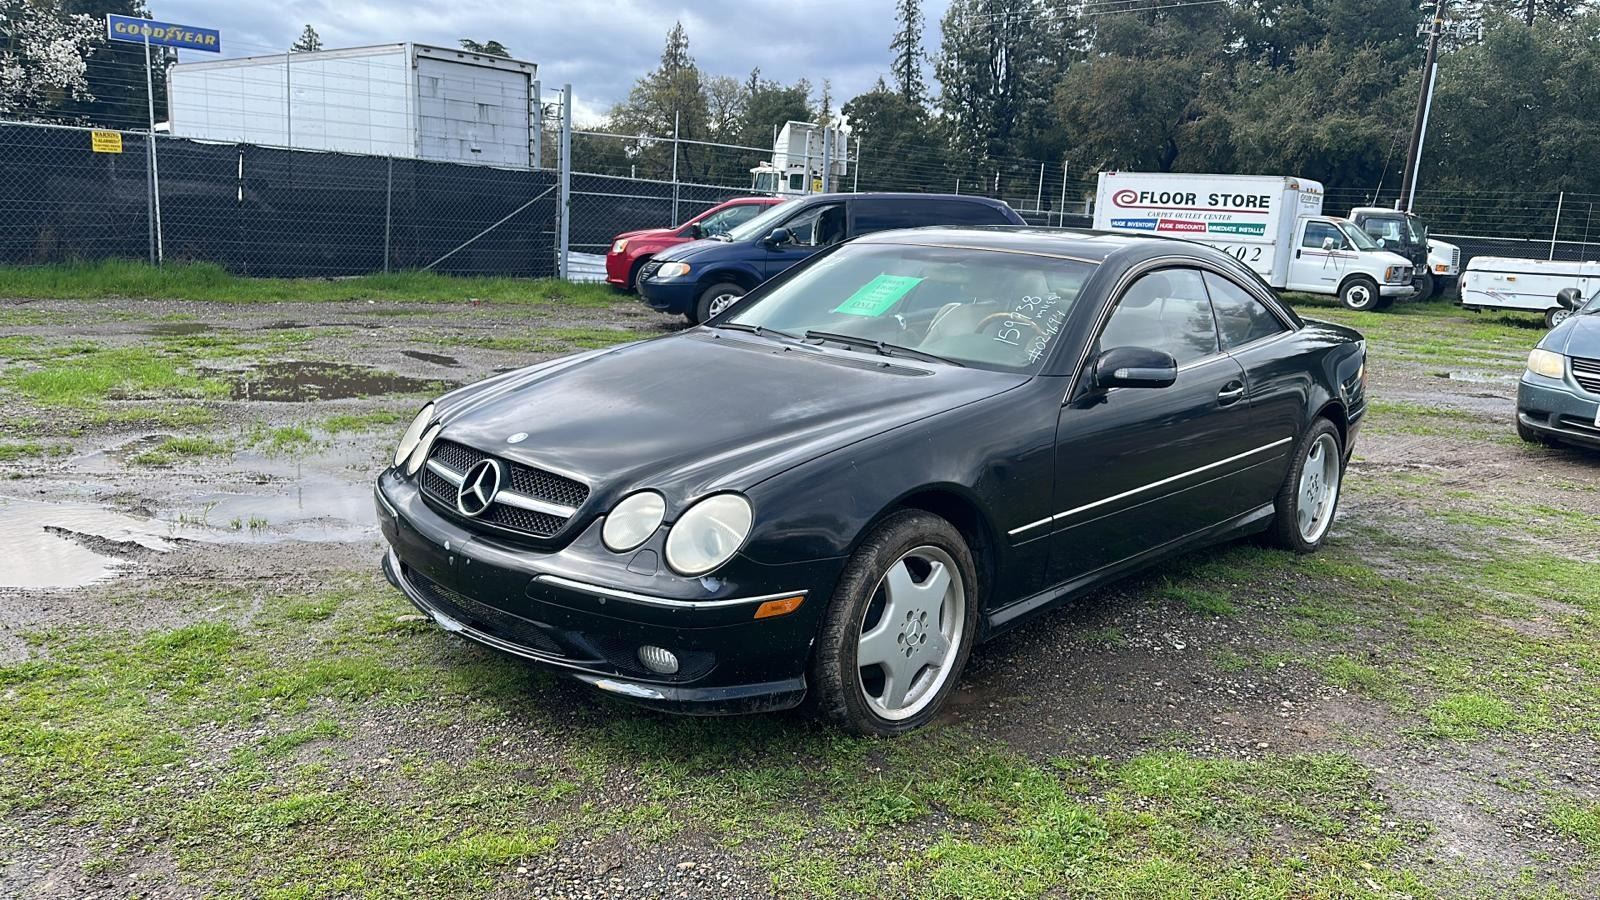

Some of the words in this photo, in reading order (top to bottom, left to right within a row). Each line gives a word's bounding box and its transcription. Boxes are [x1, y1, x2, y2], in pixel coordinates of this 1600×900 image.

[114, 22, 216, 45] GOODYEAR
[1139, 191, 1197, 206] FLOOR
[1207, 193, 1271, 208] STORE
[1127, 221, 1155, 229] INVENTORY
[1175, 223, 1205, 231] DISCOUNTS
